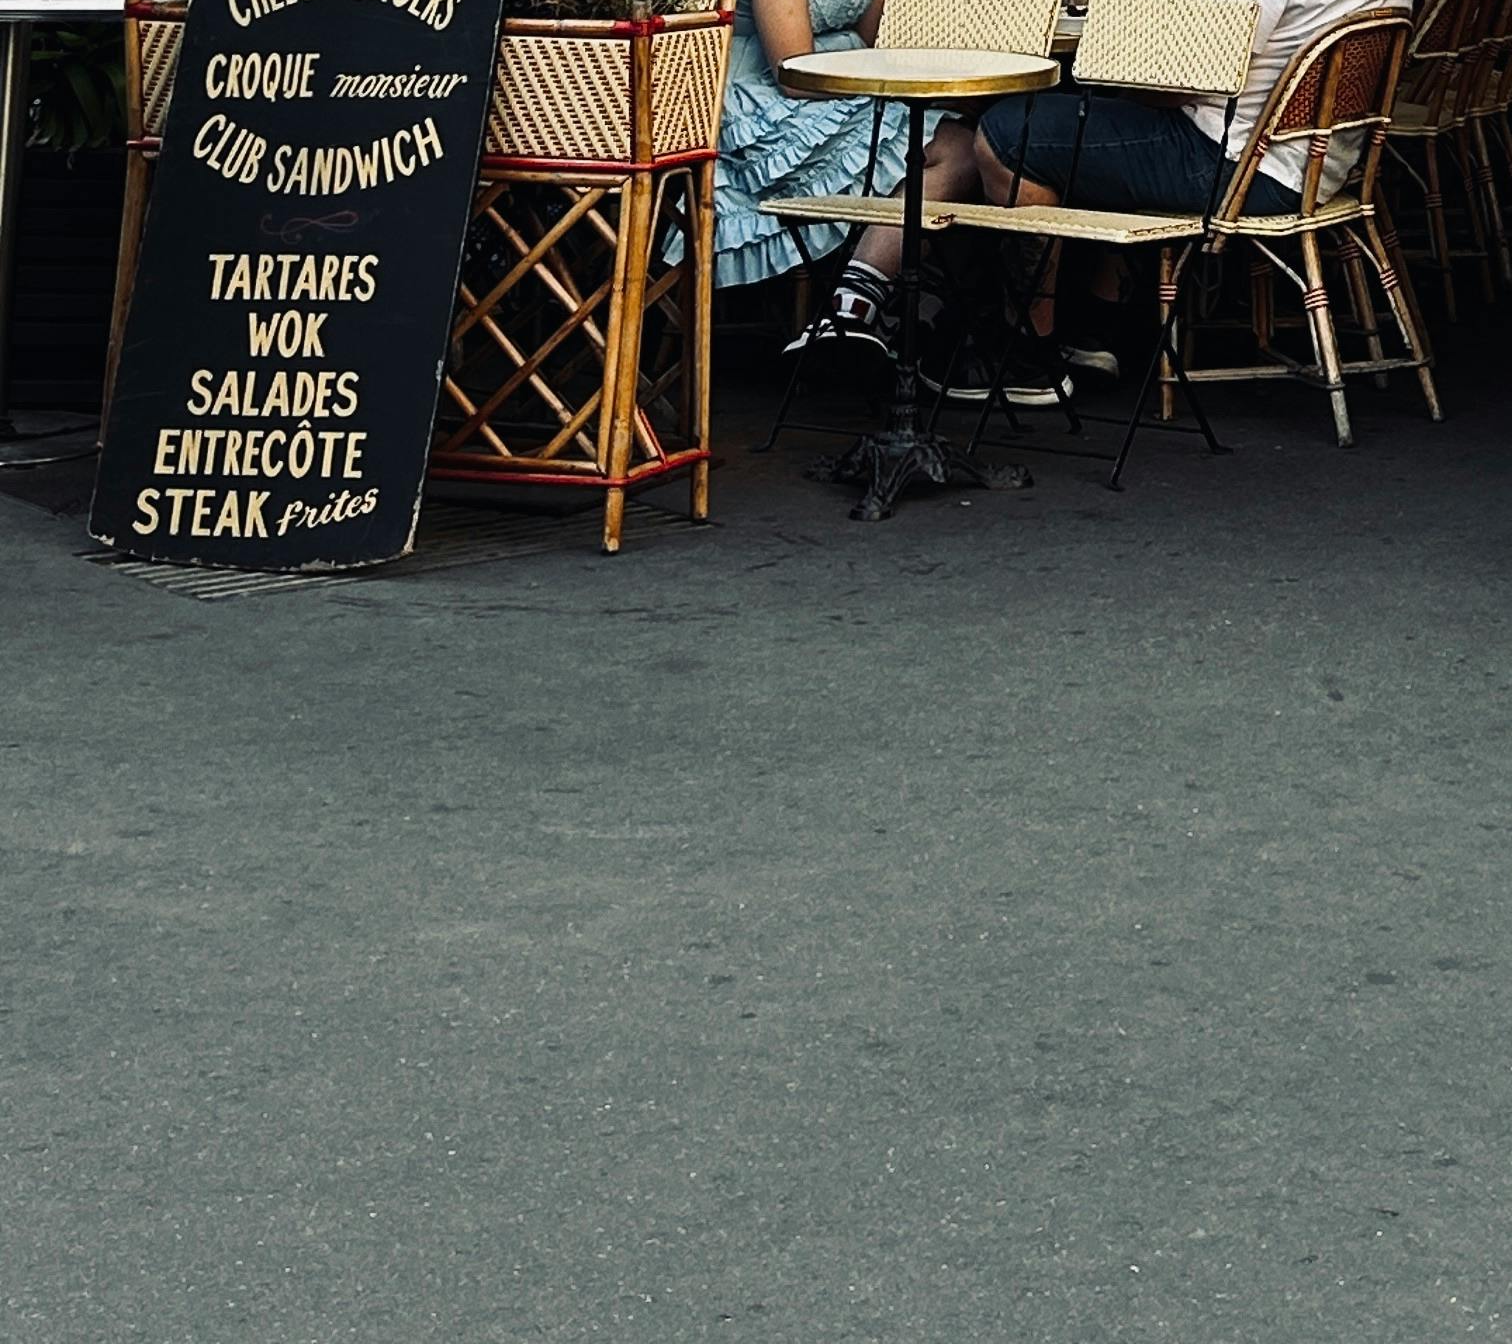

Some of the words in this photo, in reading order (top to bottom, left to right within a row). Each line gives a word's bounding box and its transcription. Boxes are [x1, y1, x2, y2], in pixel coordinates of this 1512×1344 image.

[204, 51, 321, 103] CROQUE
[328, 64, 469, 100] monsieur
[192, 113, 268, 185] CLUB
[266, 116, 445, 197] SANDWICH
[208, 253, 380, 303] TARTARES
[248, 309, 329, 358] WOK
[186, 369, 361, 419] SALADES
[153, 418, 368, 480] ENTRECÔTE
[131, 487, 271, 539] STEAK
[274, 487, 380, 538] frites
